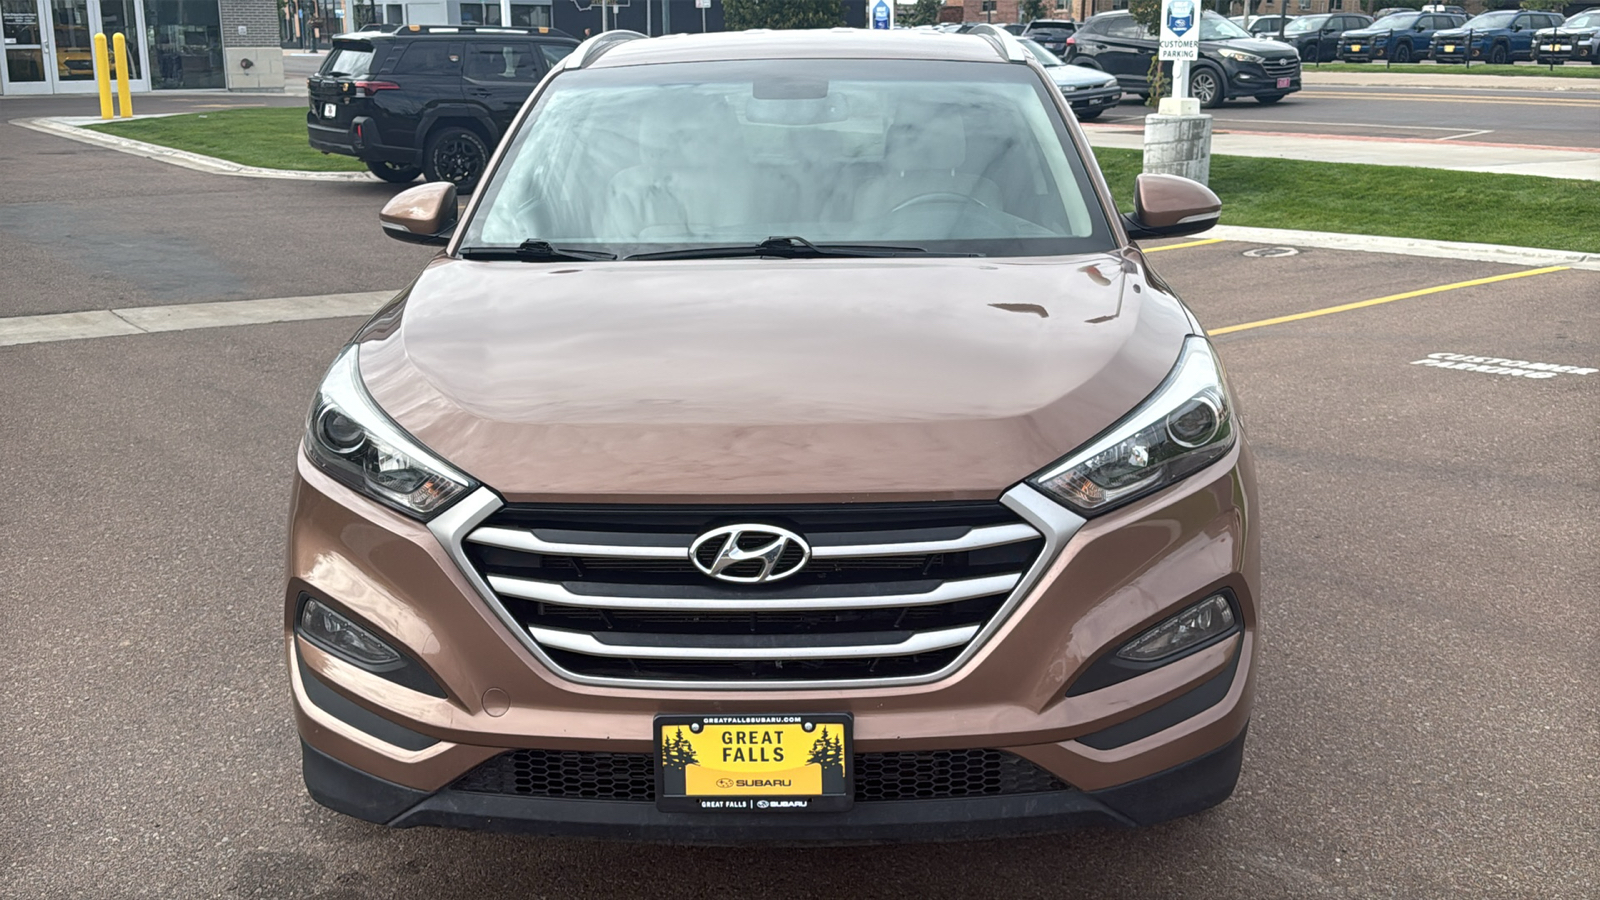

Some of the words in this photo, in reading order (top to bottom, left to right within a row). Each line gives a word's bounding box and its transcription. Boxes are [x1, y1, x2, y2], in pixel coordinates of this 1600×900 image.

[1159, 40, 1199, 48] CUSTOMER
[1162, 50, 1194, 58] PARKING
[721, 730, 784, 745] GREAT
[722, 747, 785, 762] FALLS
[735, 779, 792, 787] SUBARU
